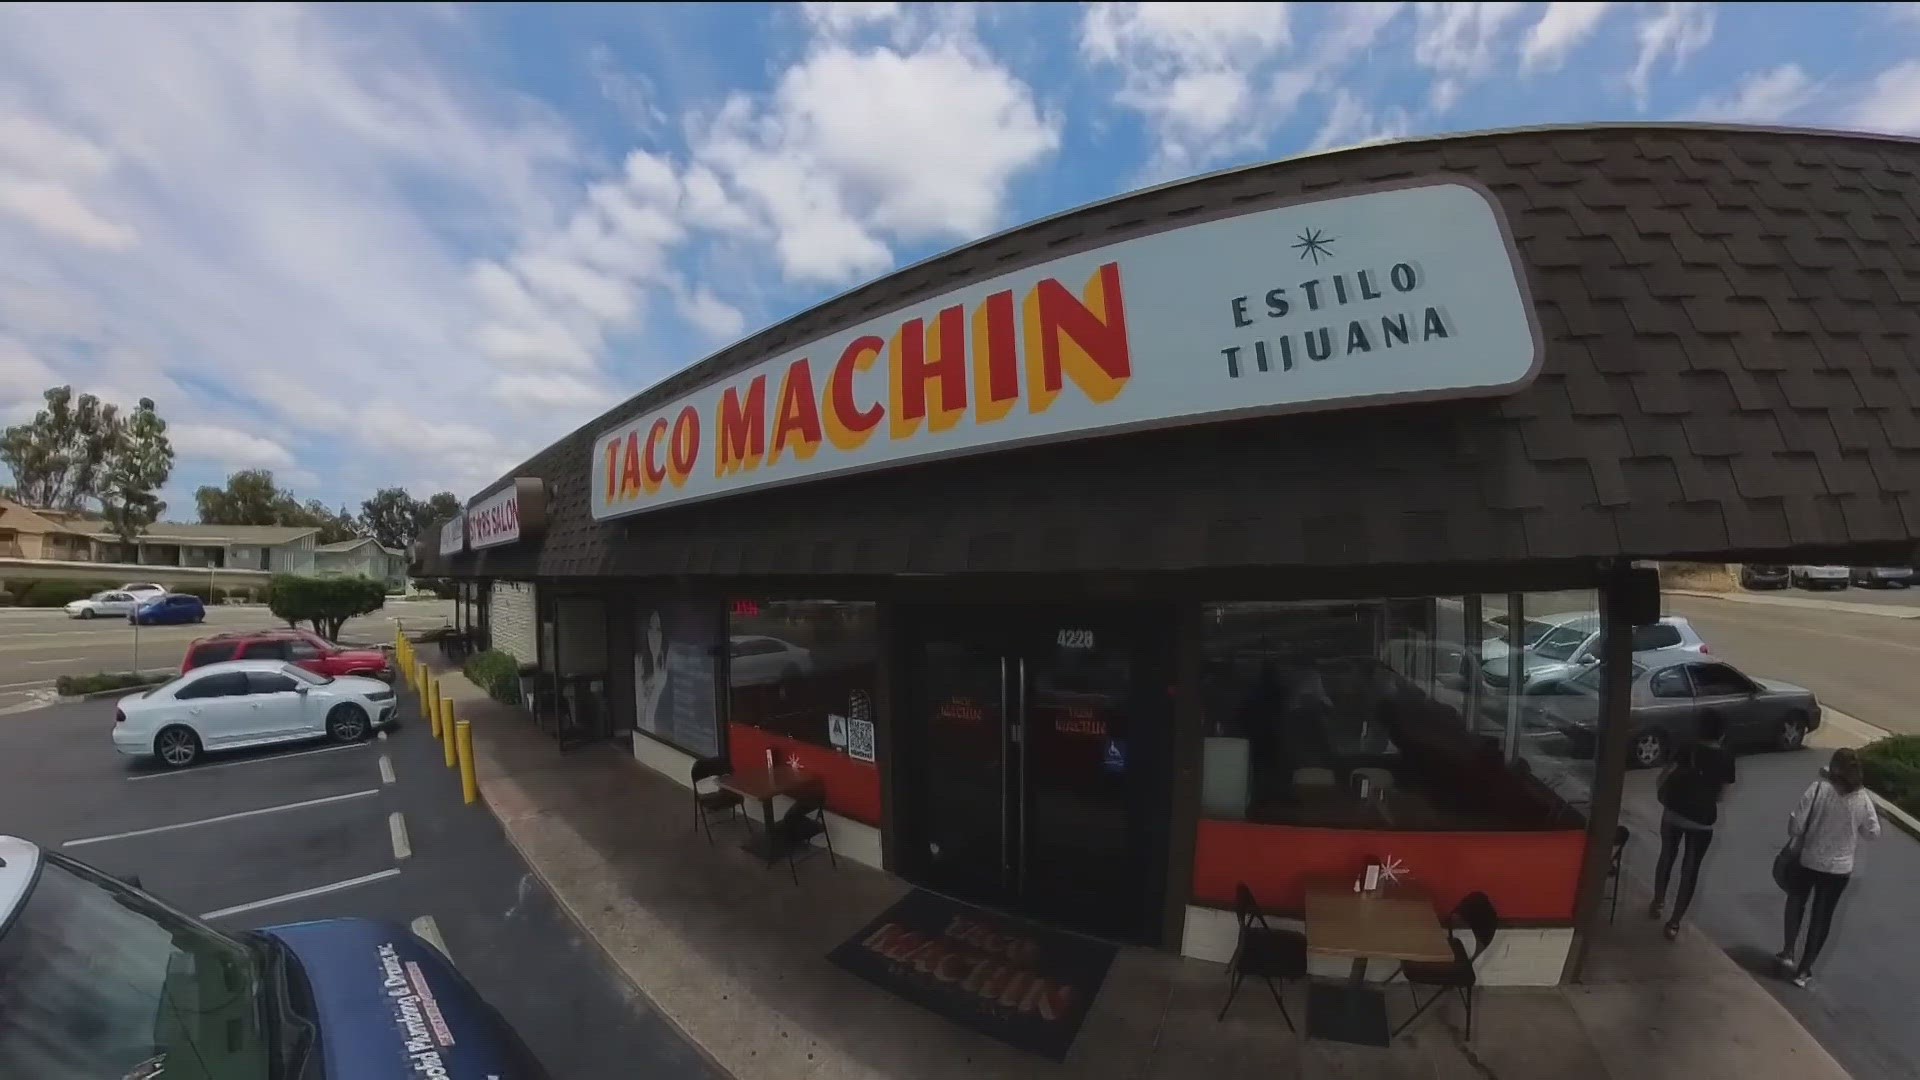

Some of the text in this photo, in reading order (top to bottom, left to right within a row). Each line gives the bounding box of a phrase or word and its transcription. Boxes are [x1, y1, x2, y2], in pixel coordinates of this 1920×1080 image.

[1231, 262, 1419, 328] ESTILO
[1220, 306, 1450, 379] TIJUANA
[604, 261, 1132, 504] TACO MACHIN
